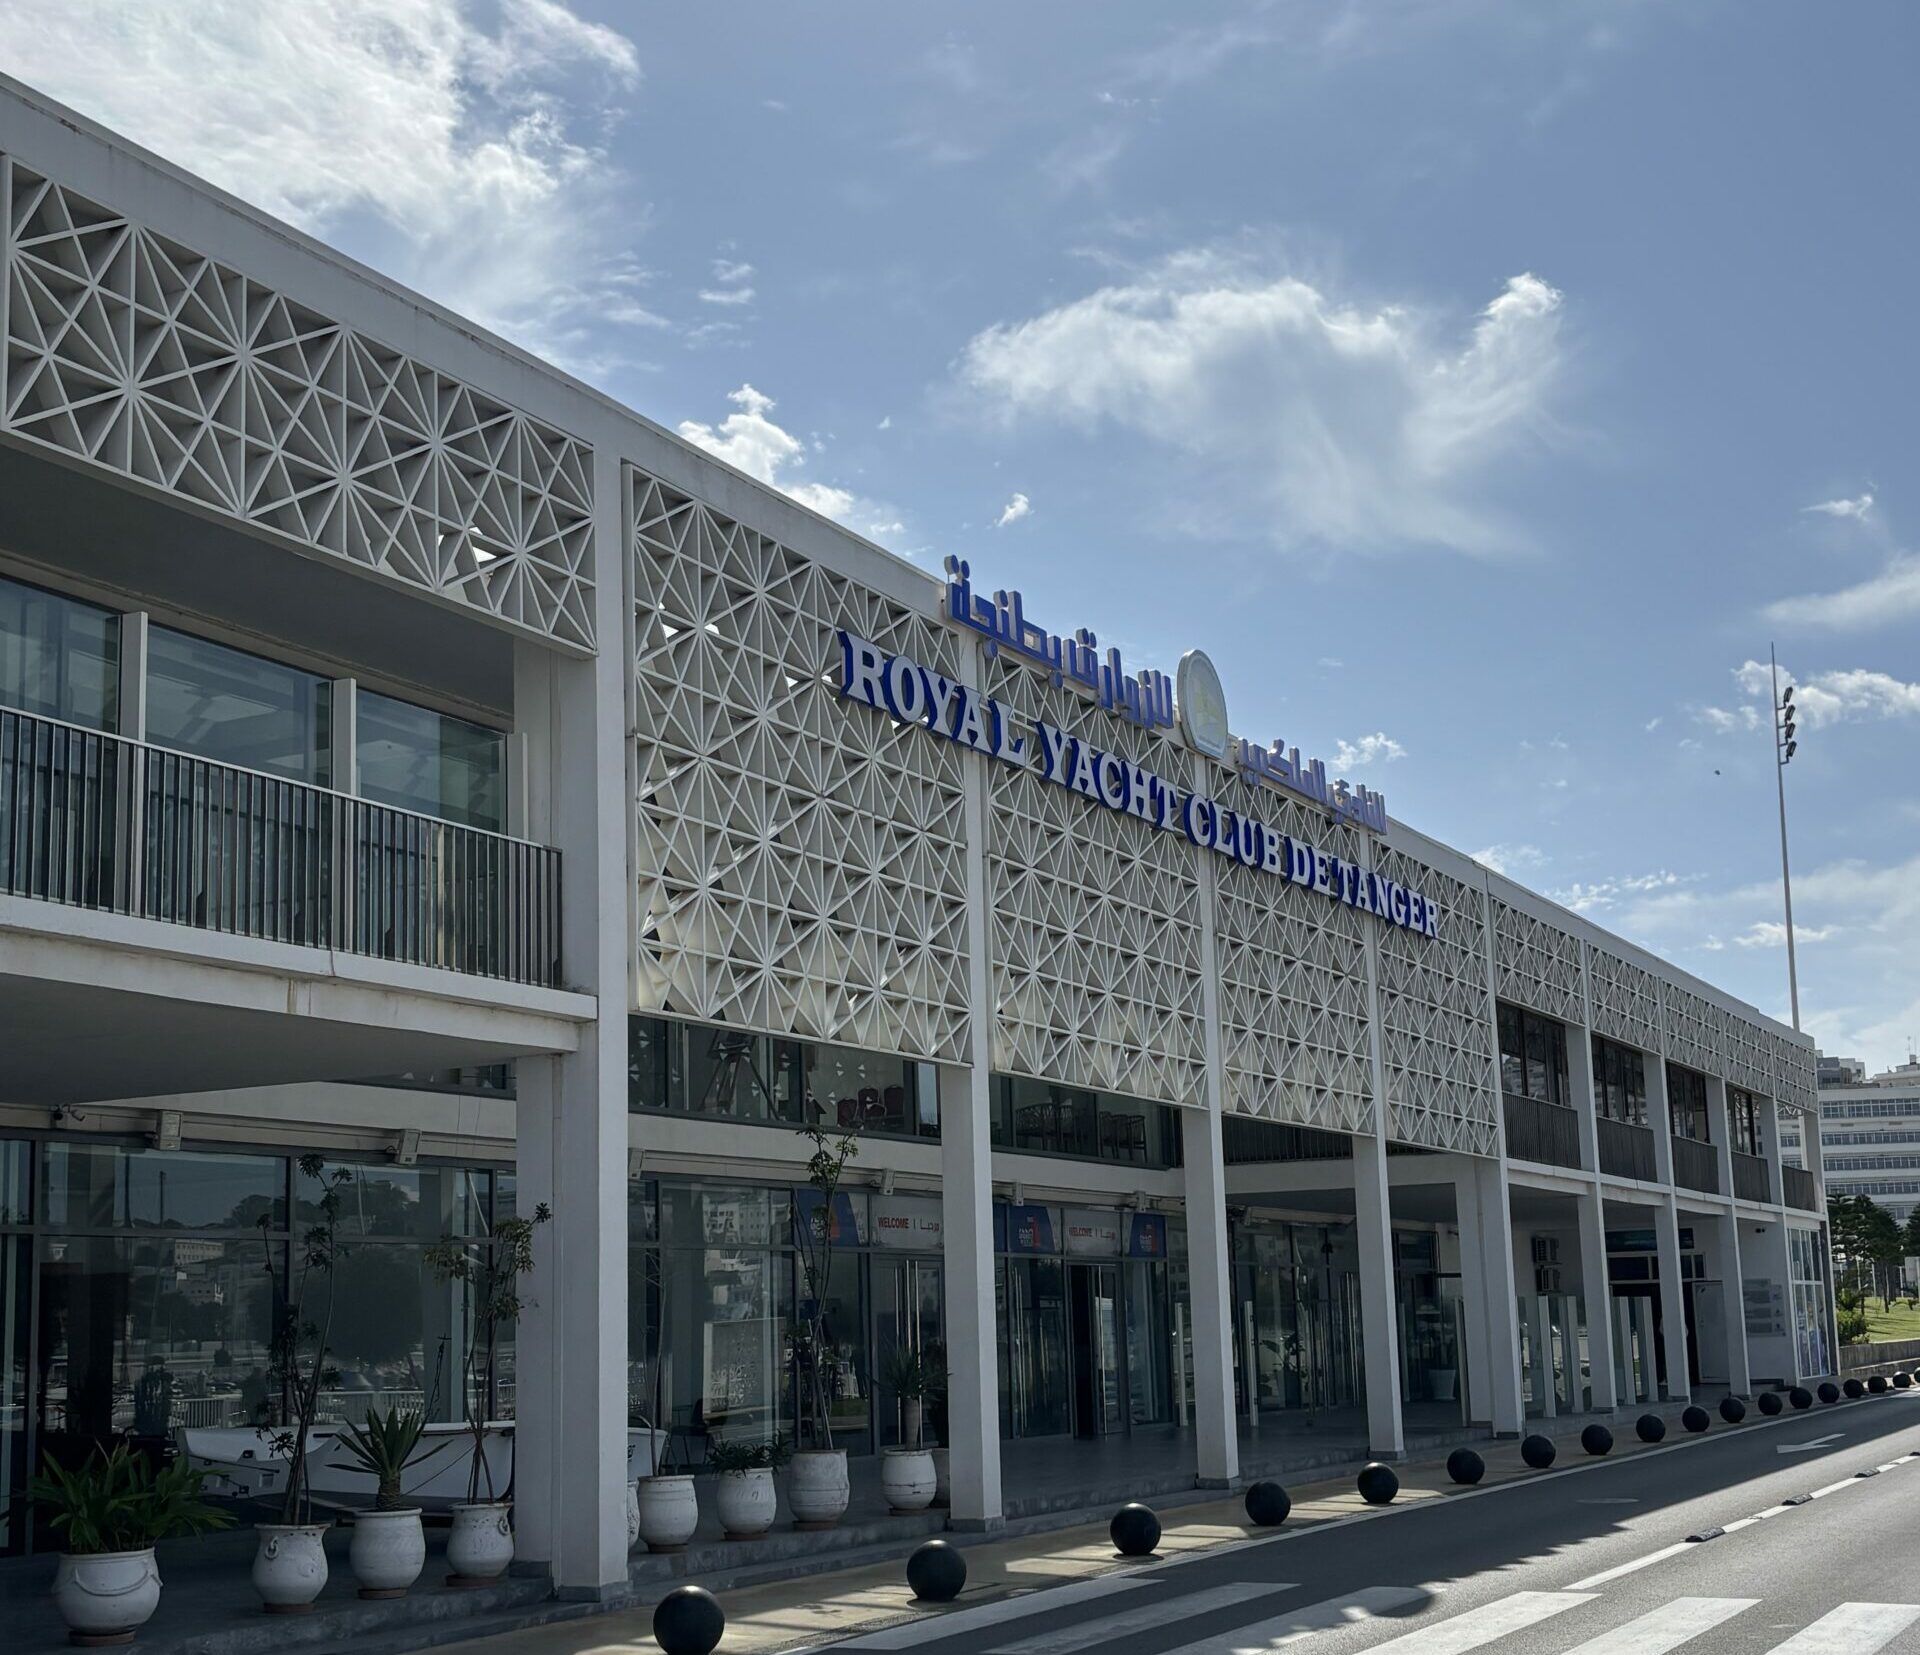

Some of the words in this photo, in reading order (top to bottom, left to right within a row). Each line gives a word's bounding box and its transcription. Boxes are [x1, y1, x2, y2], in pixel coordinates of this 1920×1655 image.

[943, 554, 1064, 689] بطنجة
[837, 630, 1026, 769] ROYAL
[1036, 720, 1178, 832] YACHT
[1183, 792, 1282, 876] CLUB
[1285, 835, 1332, 897] DE
[1332, 858, 1440, 940] TANGER
[877, 1216, 910, 1230] WELCOME
[1068, 1226, 1092, 1238] WELCOME
